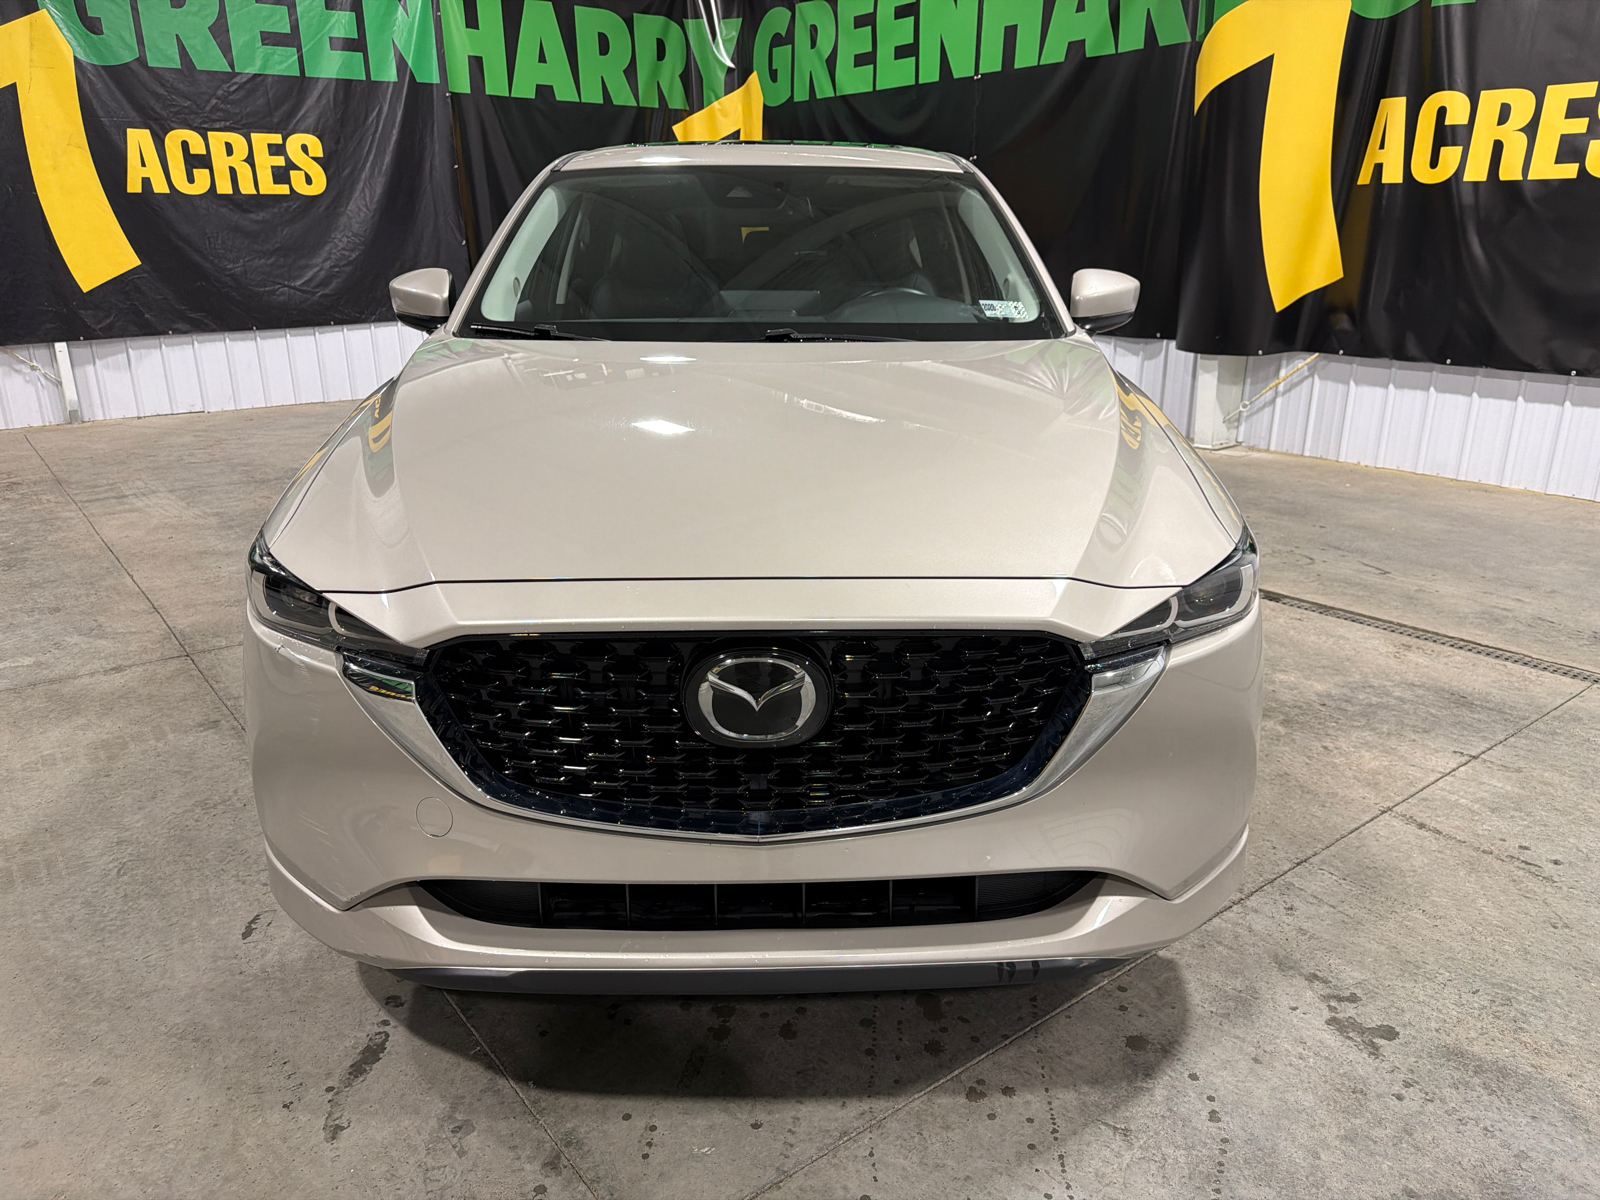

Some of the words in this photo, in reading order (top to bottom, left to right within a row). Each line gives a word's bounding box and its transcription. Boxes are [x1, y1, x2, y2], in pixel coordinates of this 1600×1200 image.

[440, 0, 742, 110] HARRY
[753, 0, 978, 107] GREEN
[126, 128, 327, 196] ACRES
[1356, 81, 1600, 185] ACRE
